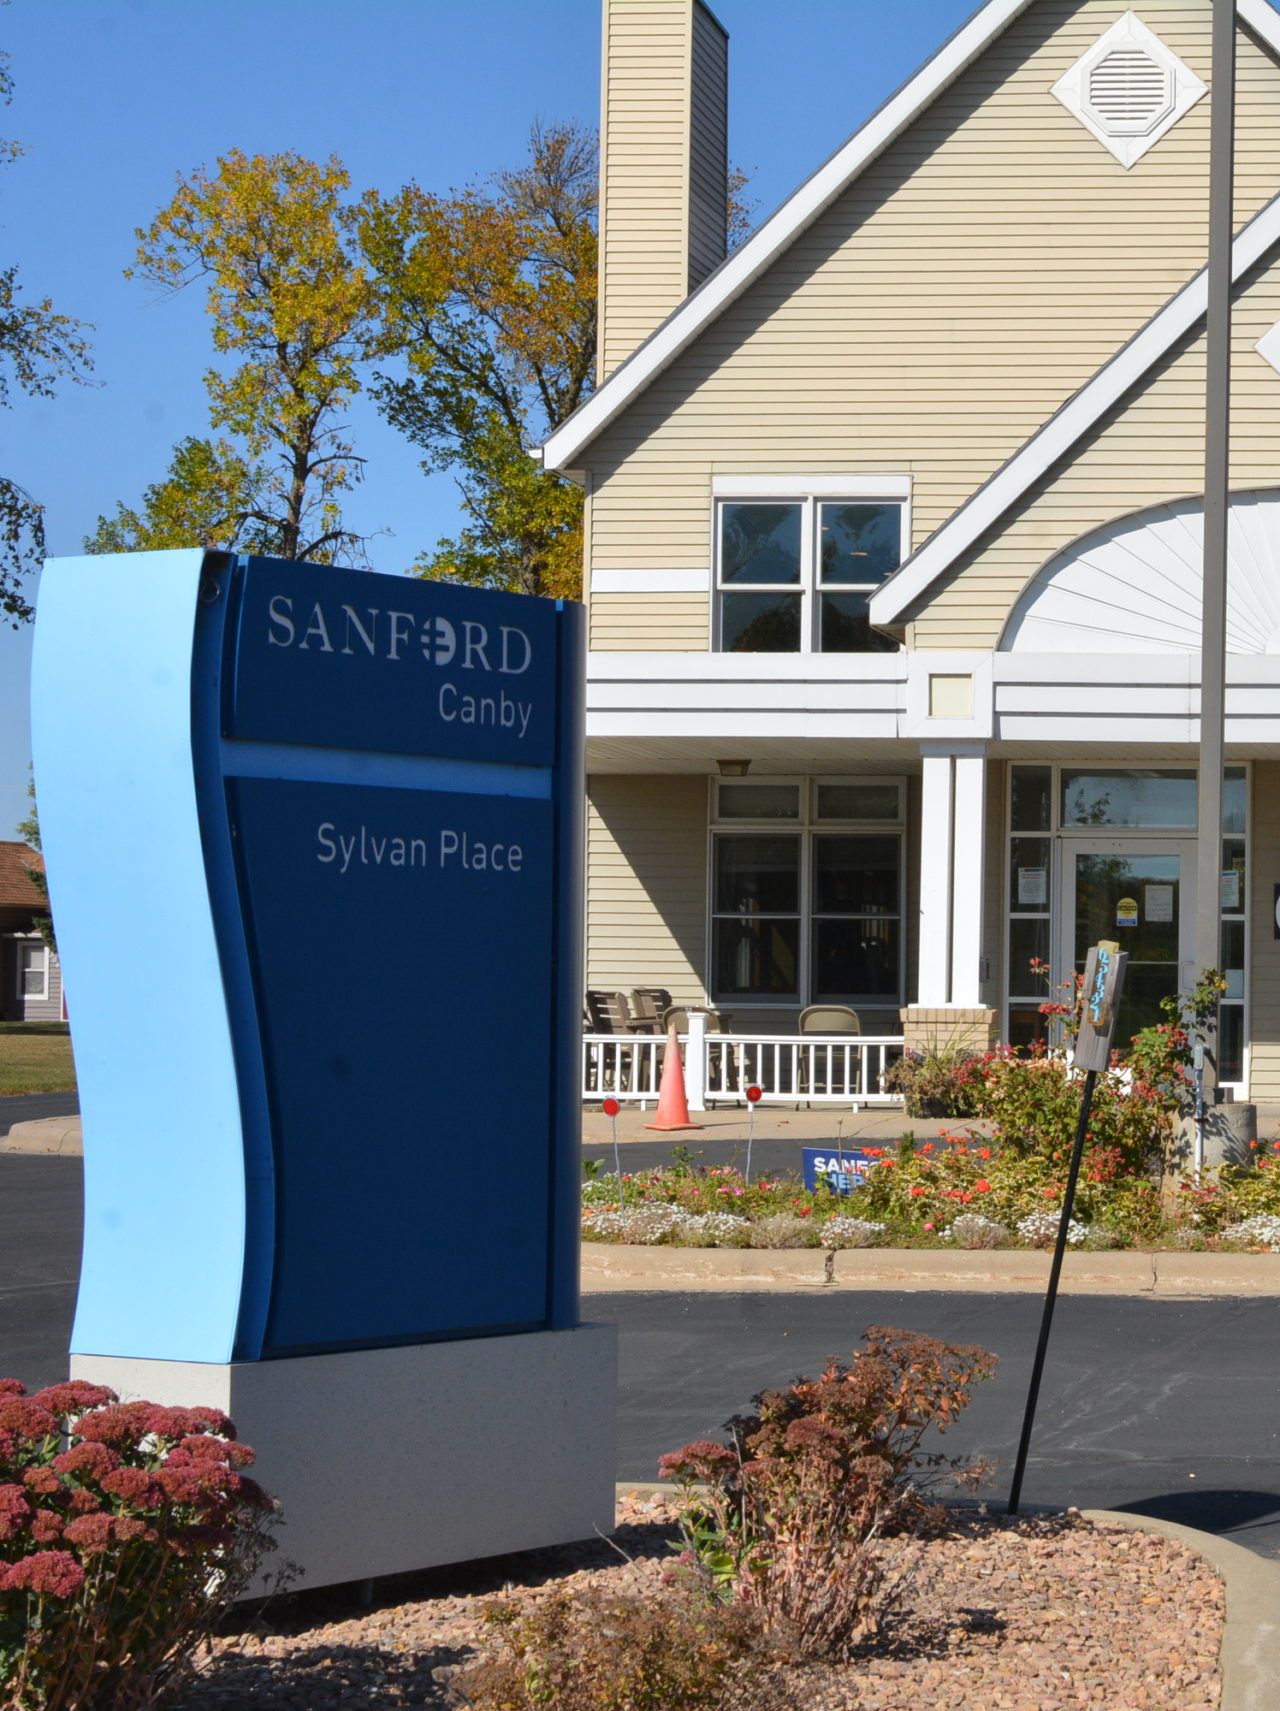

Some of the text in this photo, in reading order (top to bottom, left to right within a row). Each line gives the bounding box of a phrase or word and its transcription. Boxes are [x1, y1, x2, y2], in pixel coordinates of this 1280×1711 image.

[269, 596, 532, 674] SANFORD
[439, 683, 532, 738] Canby
[317, 823, 523, 873] Sylvan Place
